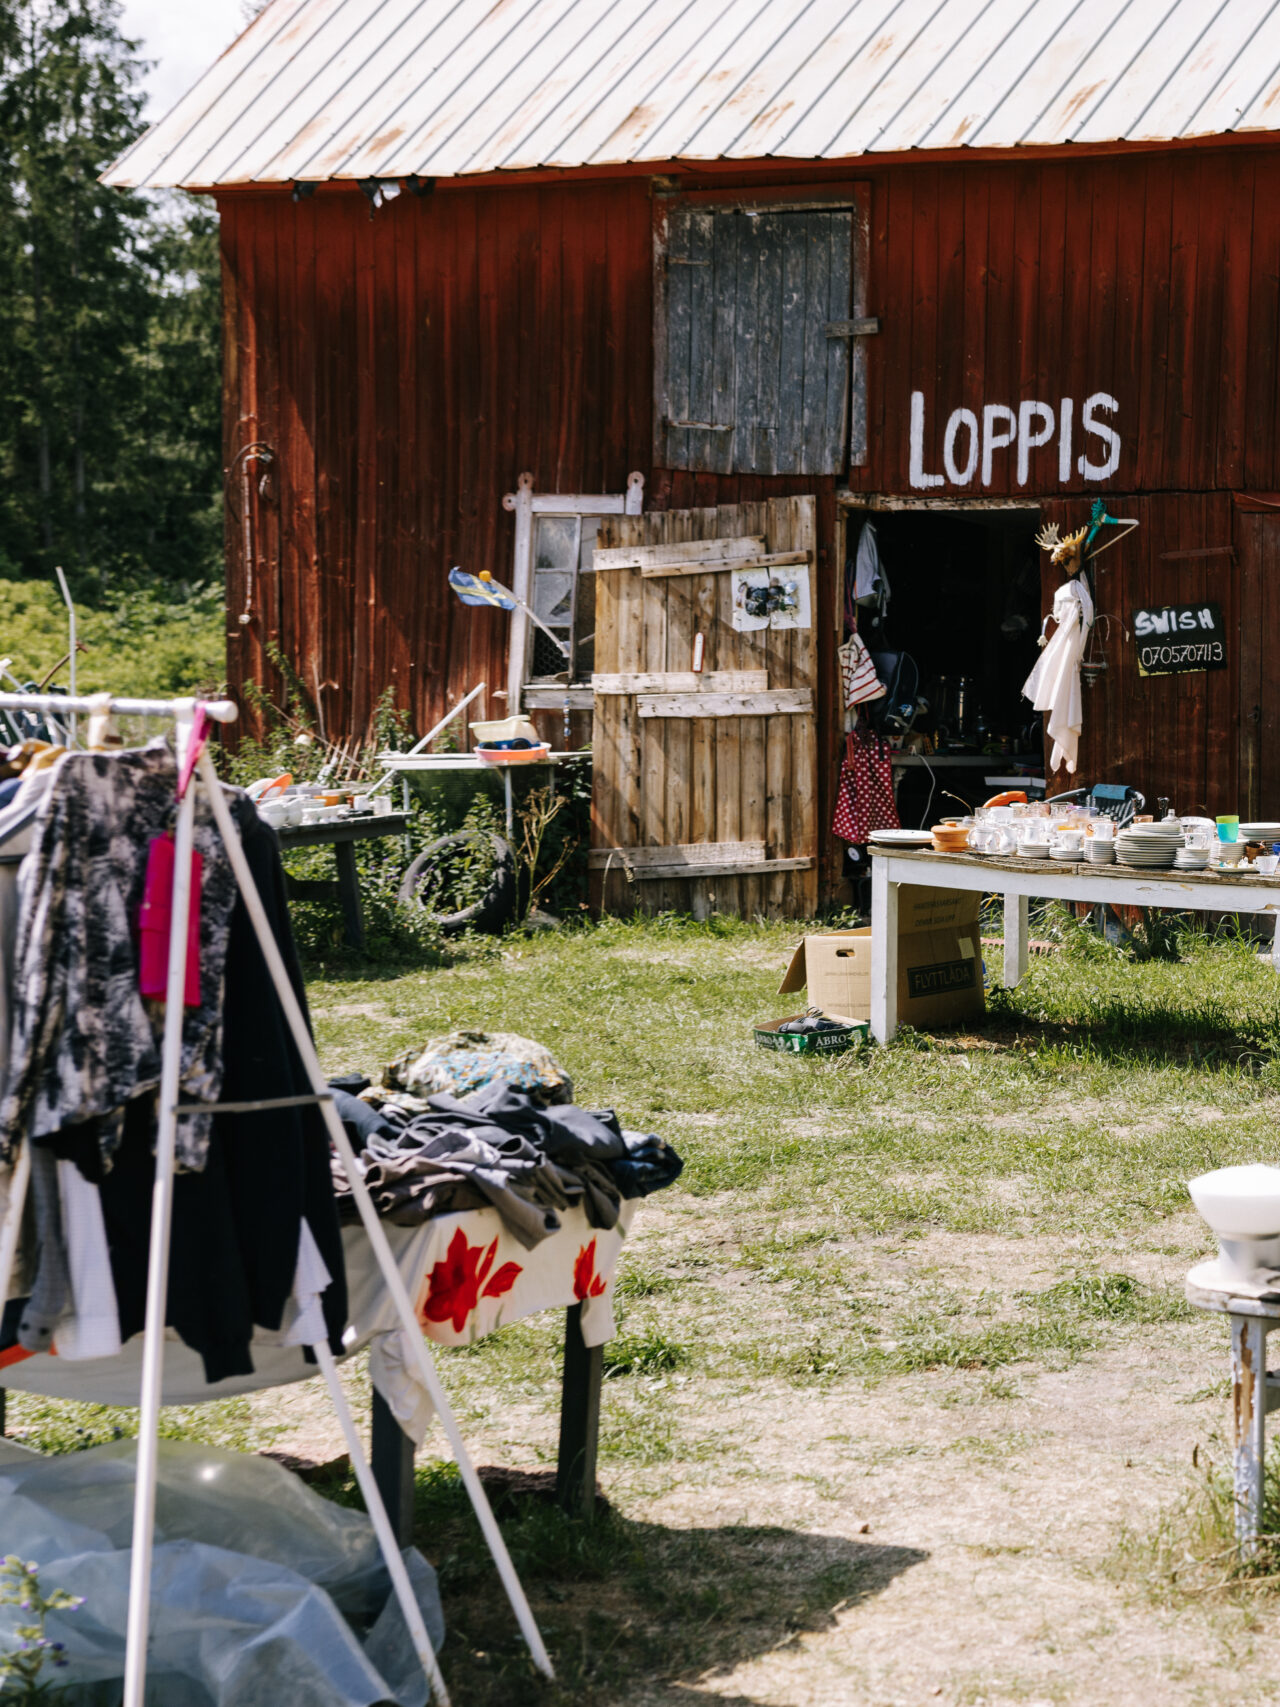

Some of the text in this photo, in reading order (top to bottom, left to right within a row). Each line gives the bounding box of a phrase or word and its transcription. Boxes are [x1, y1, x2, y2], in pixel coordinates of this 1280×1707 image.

[909, 391, 1121, 489] LOPPIS
[1135, 608, 1215, 636] SWISH
[1142, 642, 1223, 667] 0705707113
